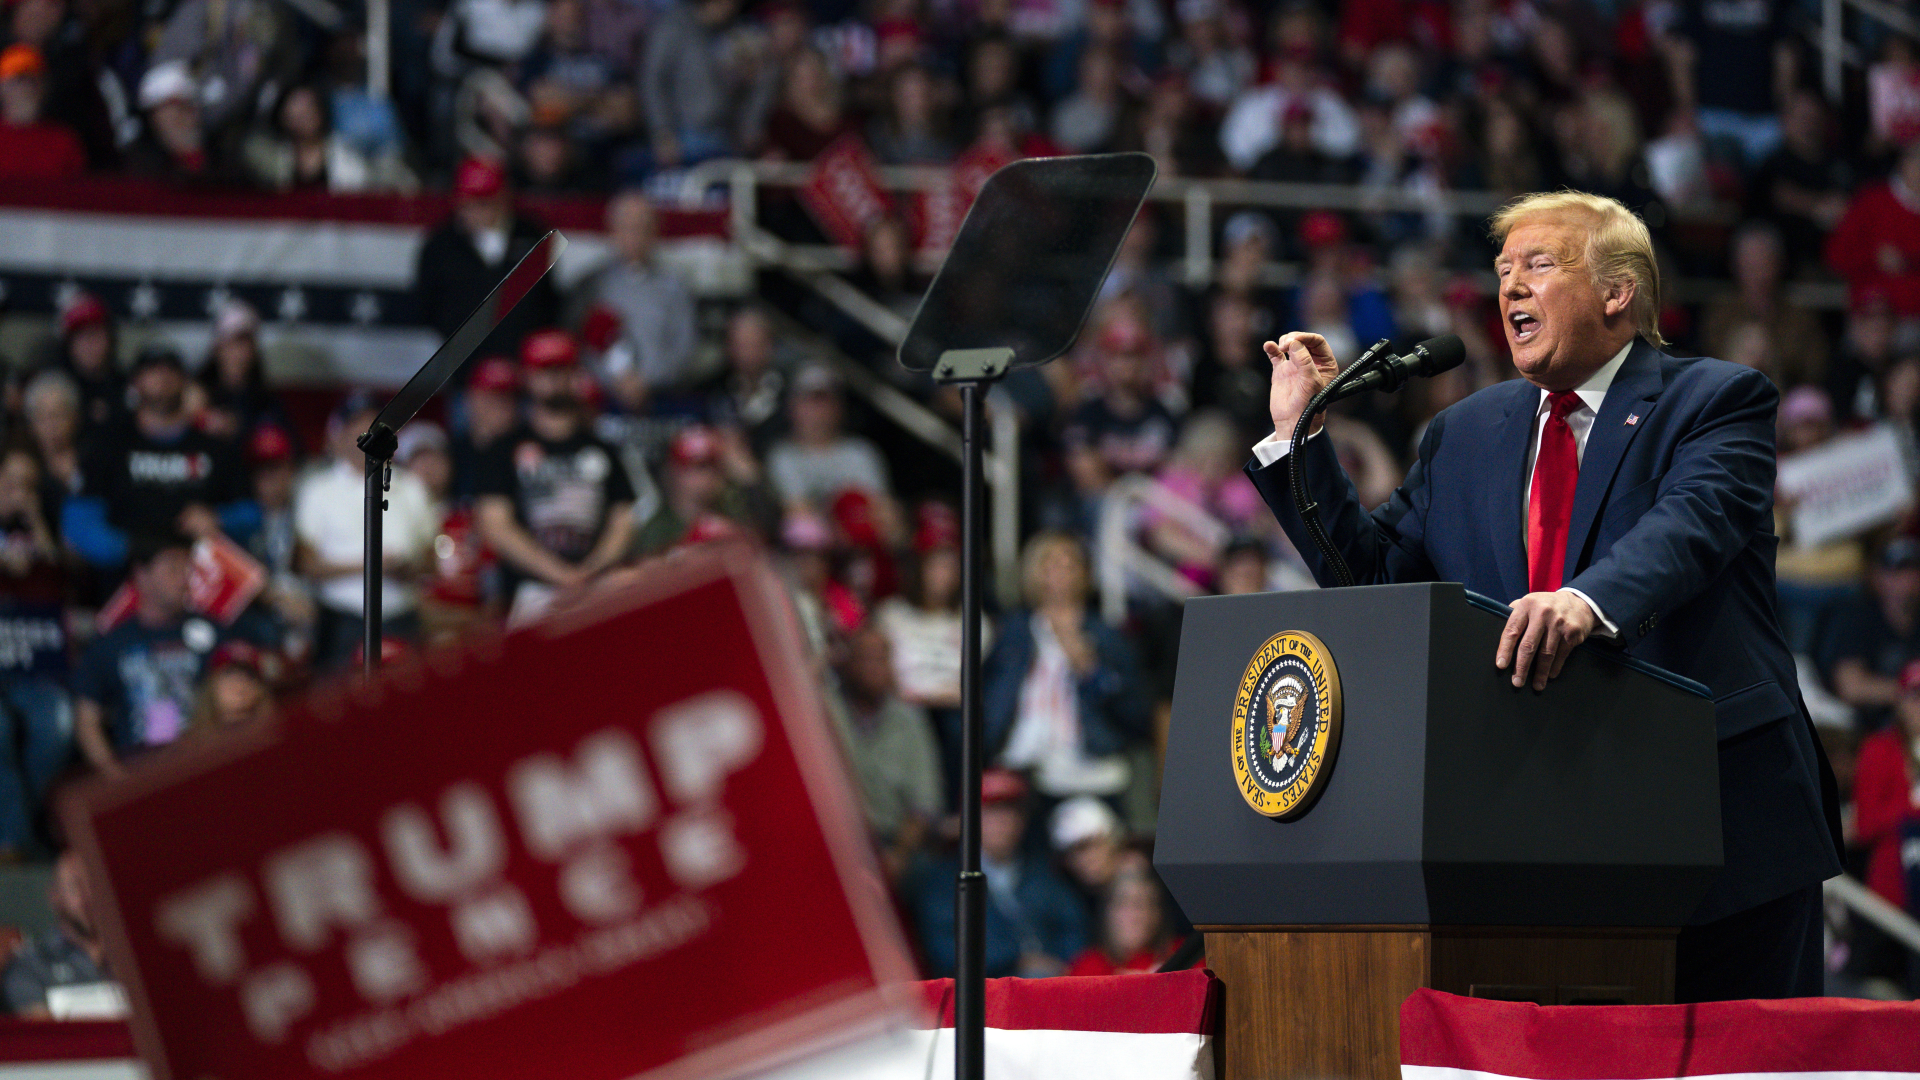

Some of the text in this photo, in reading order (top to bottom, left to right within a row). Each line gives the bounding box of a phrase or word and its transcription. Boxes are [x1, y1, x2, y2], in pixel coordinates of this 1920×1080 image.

[1289, 639, 1299, 651] OF
[1300, 643, 1312, 660] THE
[1237, 638, 1287, 719] PRESIDENT
[1312, 658, 1329, 733] UNITED
[1237, 755, 1244, 770] OF
[1282, 751, 1320, 807] STATES
[1242, 769, 1265, 807] SEAL
[155, 690, 765, 985] TRUMP
